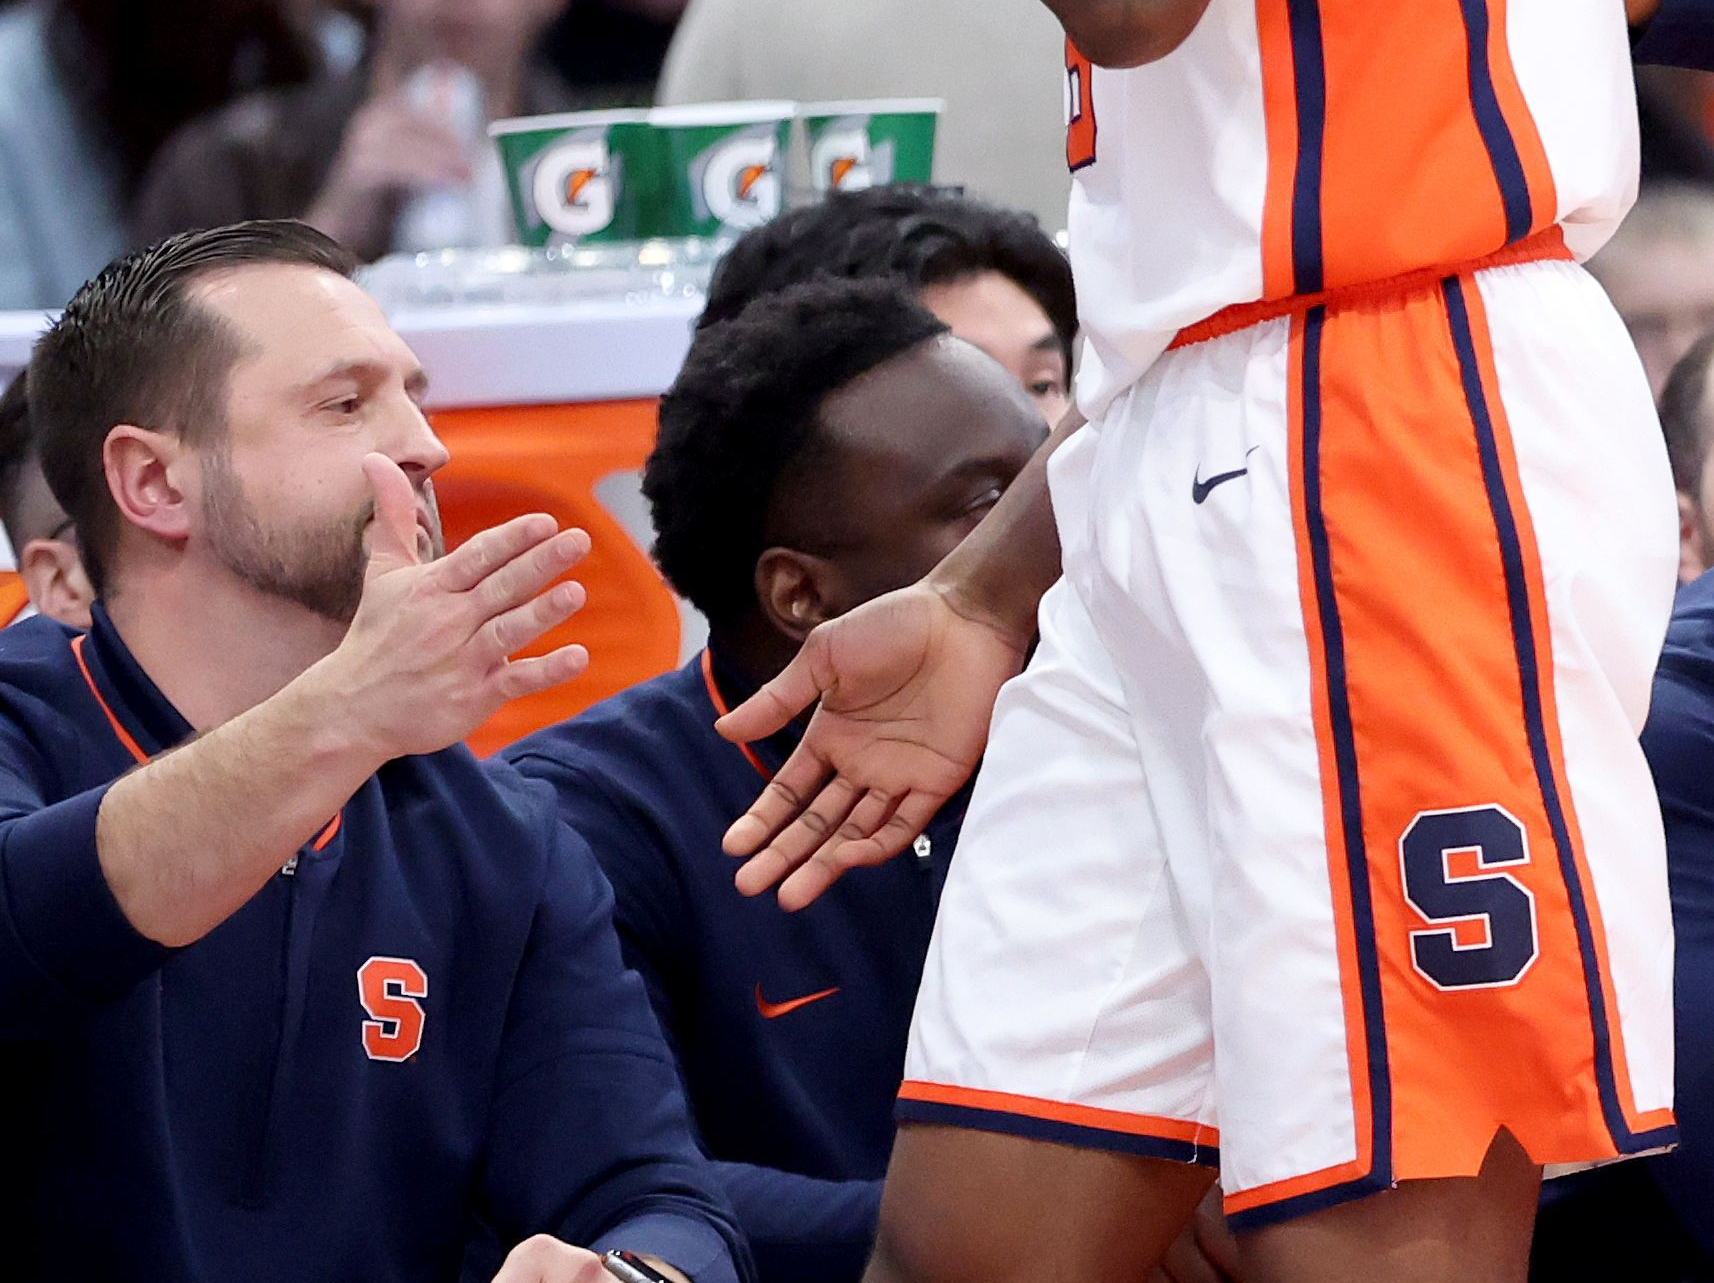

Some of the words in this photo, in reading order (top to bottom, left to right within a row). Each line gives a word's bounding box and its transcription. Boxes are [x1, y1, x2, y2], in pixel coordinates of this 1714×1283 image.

[533, 136, 615, 235] G
[702, 135, 780, 231] G
[1398, 803, 1540, 991] S
[356, 956, 428, 1062] S
